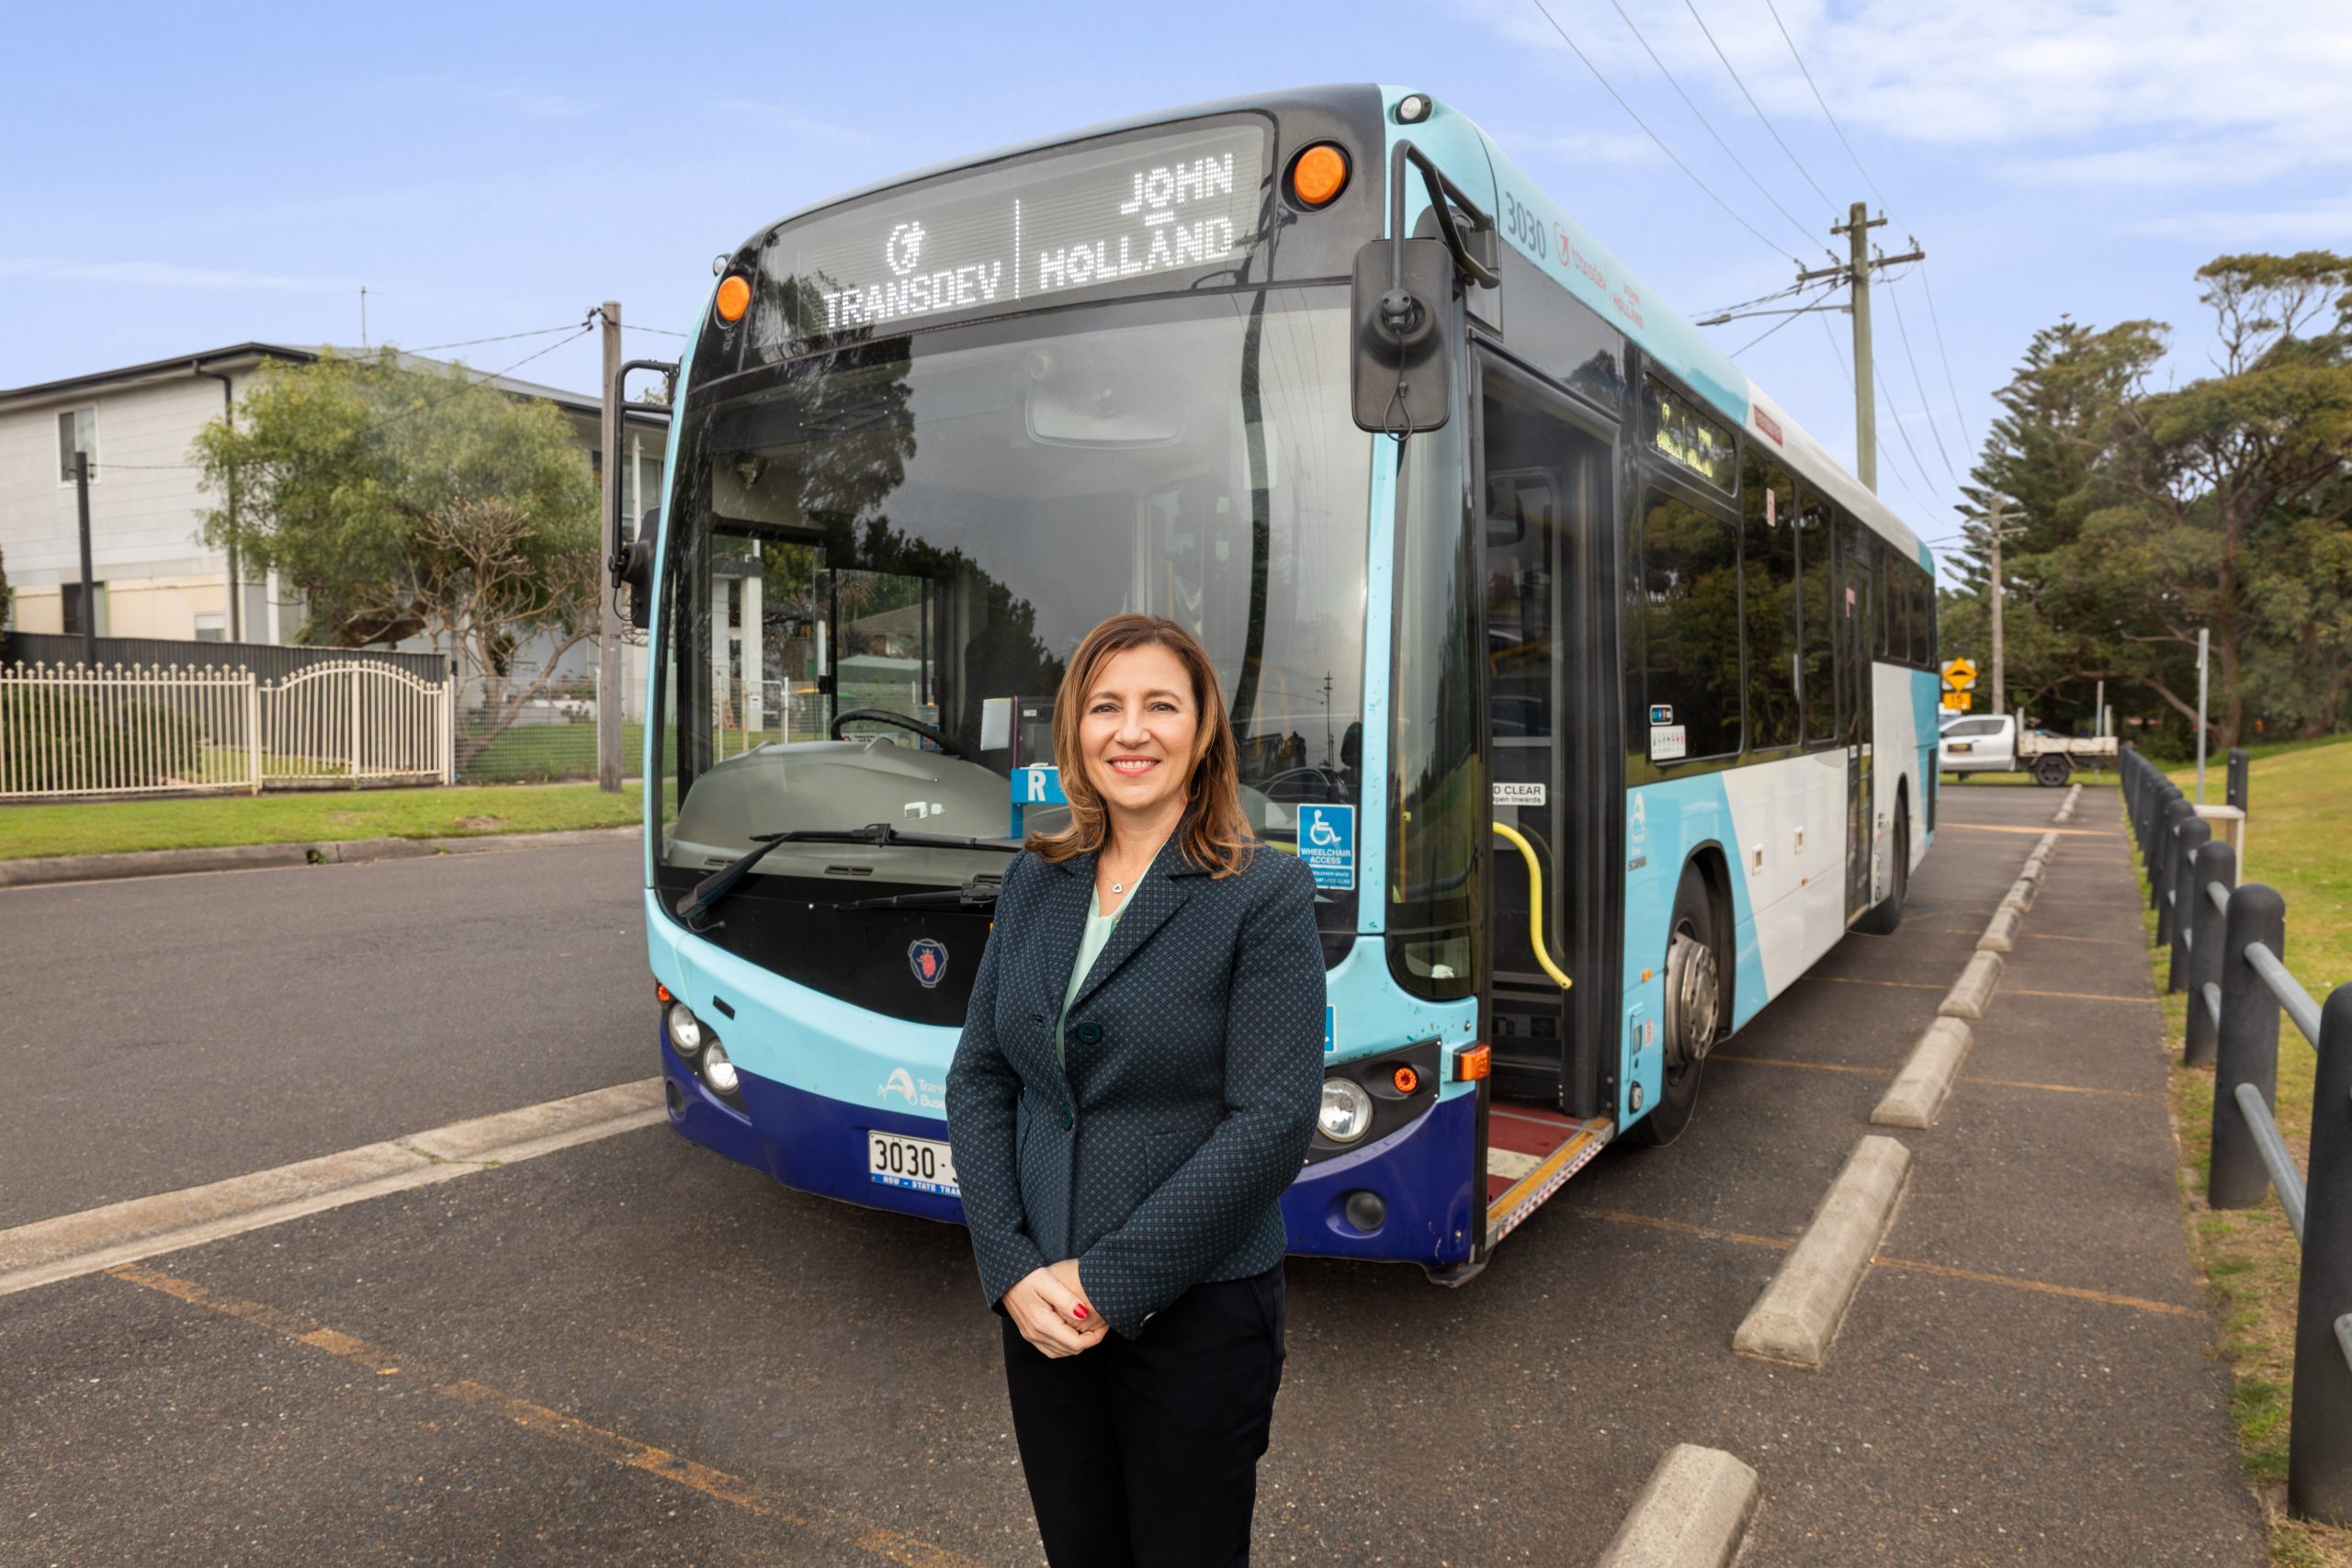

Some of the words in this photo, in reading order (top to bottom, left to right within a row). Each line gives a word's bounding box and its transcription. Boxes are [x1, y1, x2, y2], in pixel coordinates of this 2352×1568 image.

[1121, 152, 1233, 214] JOHN
[1506, 191, 1546, 260] 3030
[1040, 217, 1233, 289] HOLLAND
[823, 262, 1001, 328] TRANSDEV
[1028, 770, 1046, 802] R
[1504, 785, 1541, 795] CLEAR
[1511, 795, 1542, 804] Inwards
[1301, 848, 1351, 857] WHEELCHAIR
[1310, 856, 1340, 864] ACCESS
[921, 1095, 946, 1111] Buse
[883, 1176, 900, 1185] NSW
[911, 1180, 936, 1192] STATE
